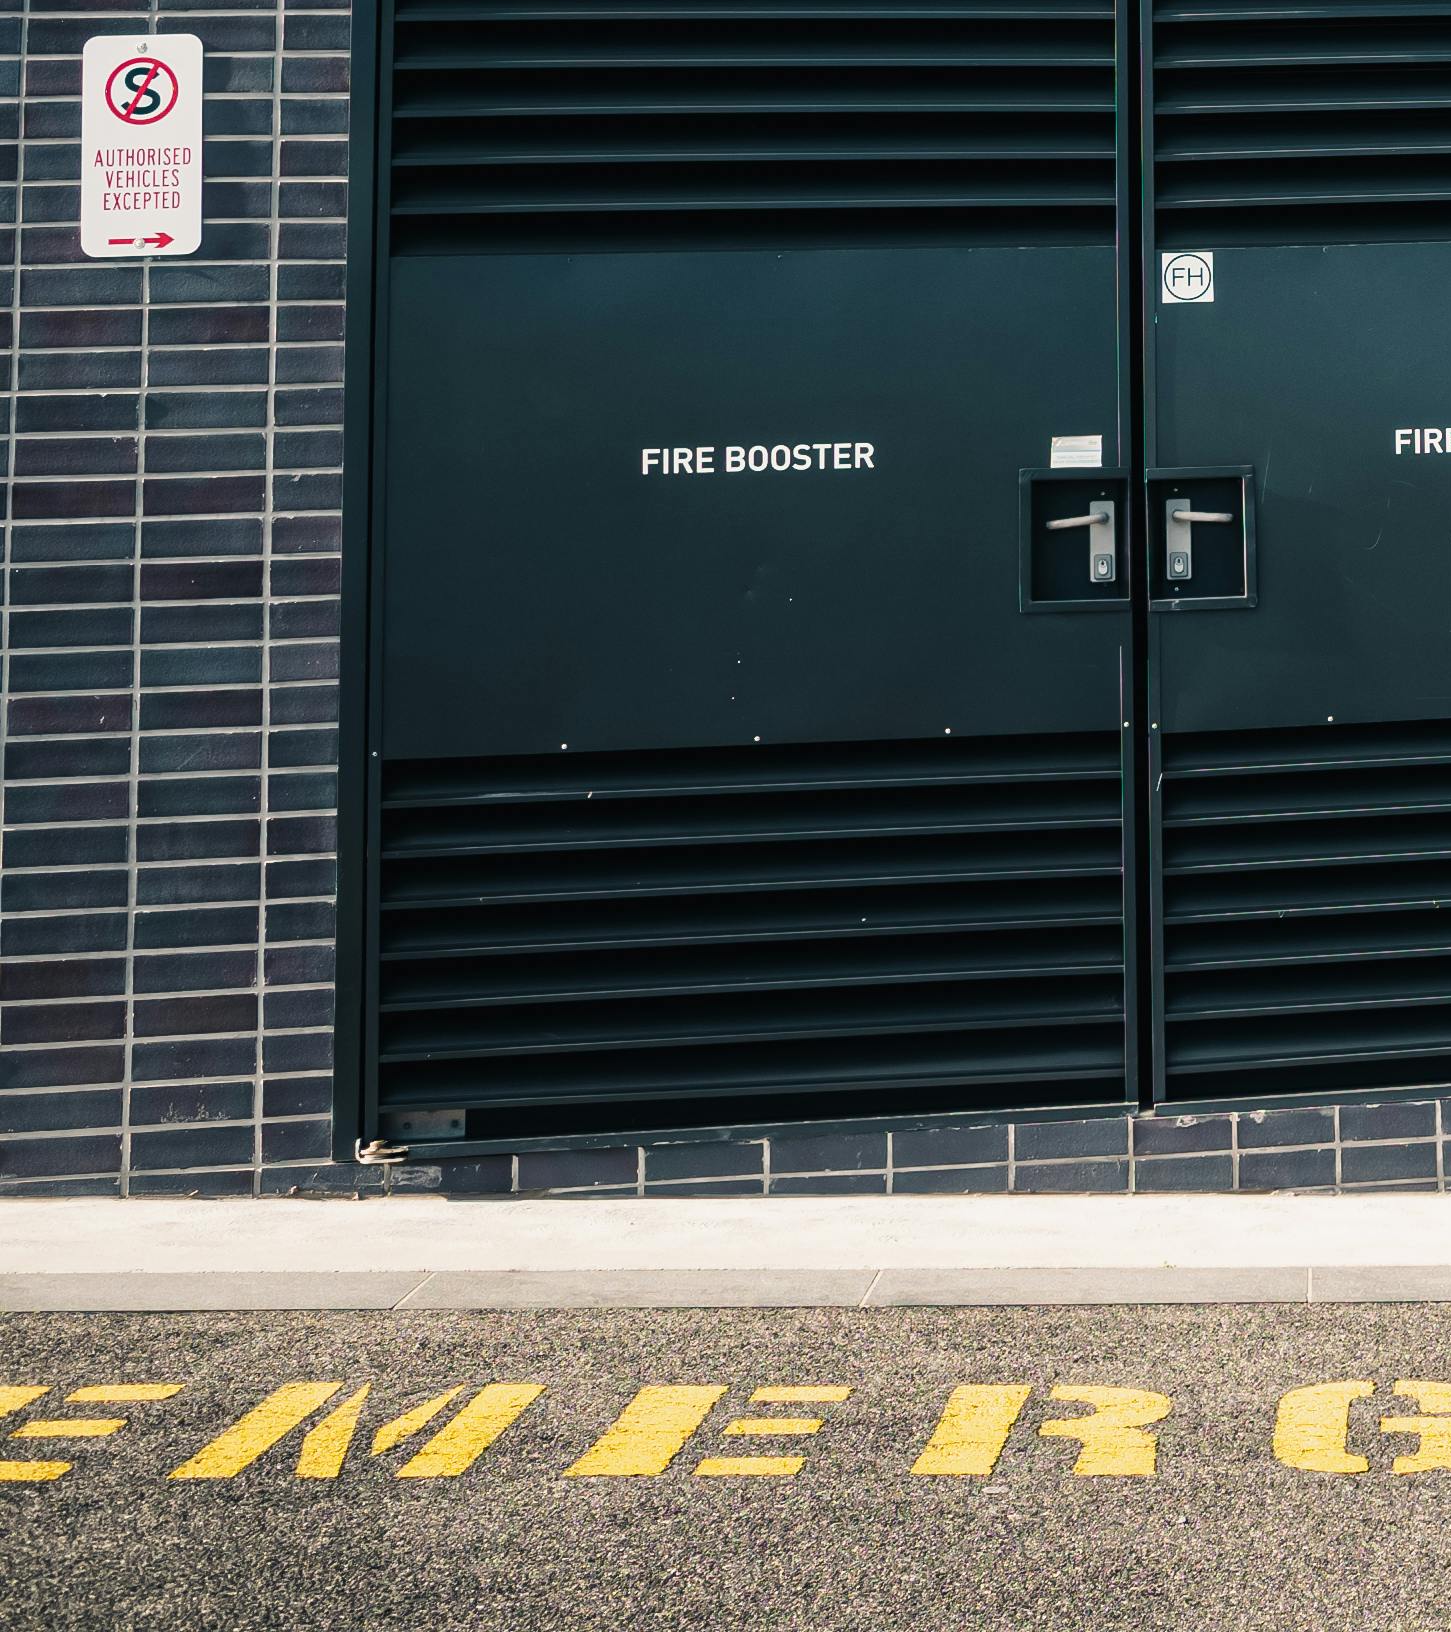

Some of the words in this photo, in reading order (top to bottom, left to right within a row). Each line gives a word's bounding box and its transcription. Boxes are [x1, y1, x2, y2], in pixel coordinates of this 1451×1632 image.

[94, 147, 191, 167] AUTHORISED
[105, 169, 180, 188] VEHICLES
[103, 191, 181, 210] EXCEPTED
[1171, 267, 1204, 287] FH
[641, 446, 715, 475] FIRE
[724, 442, 875, 473] BOOSTER
